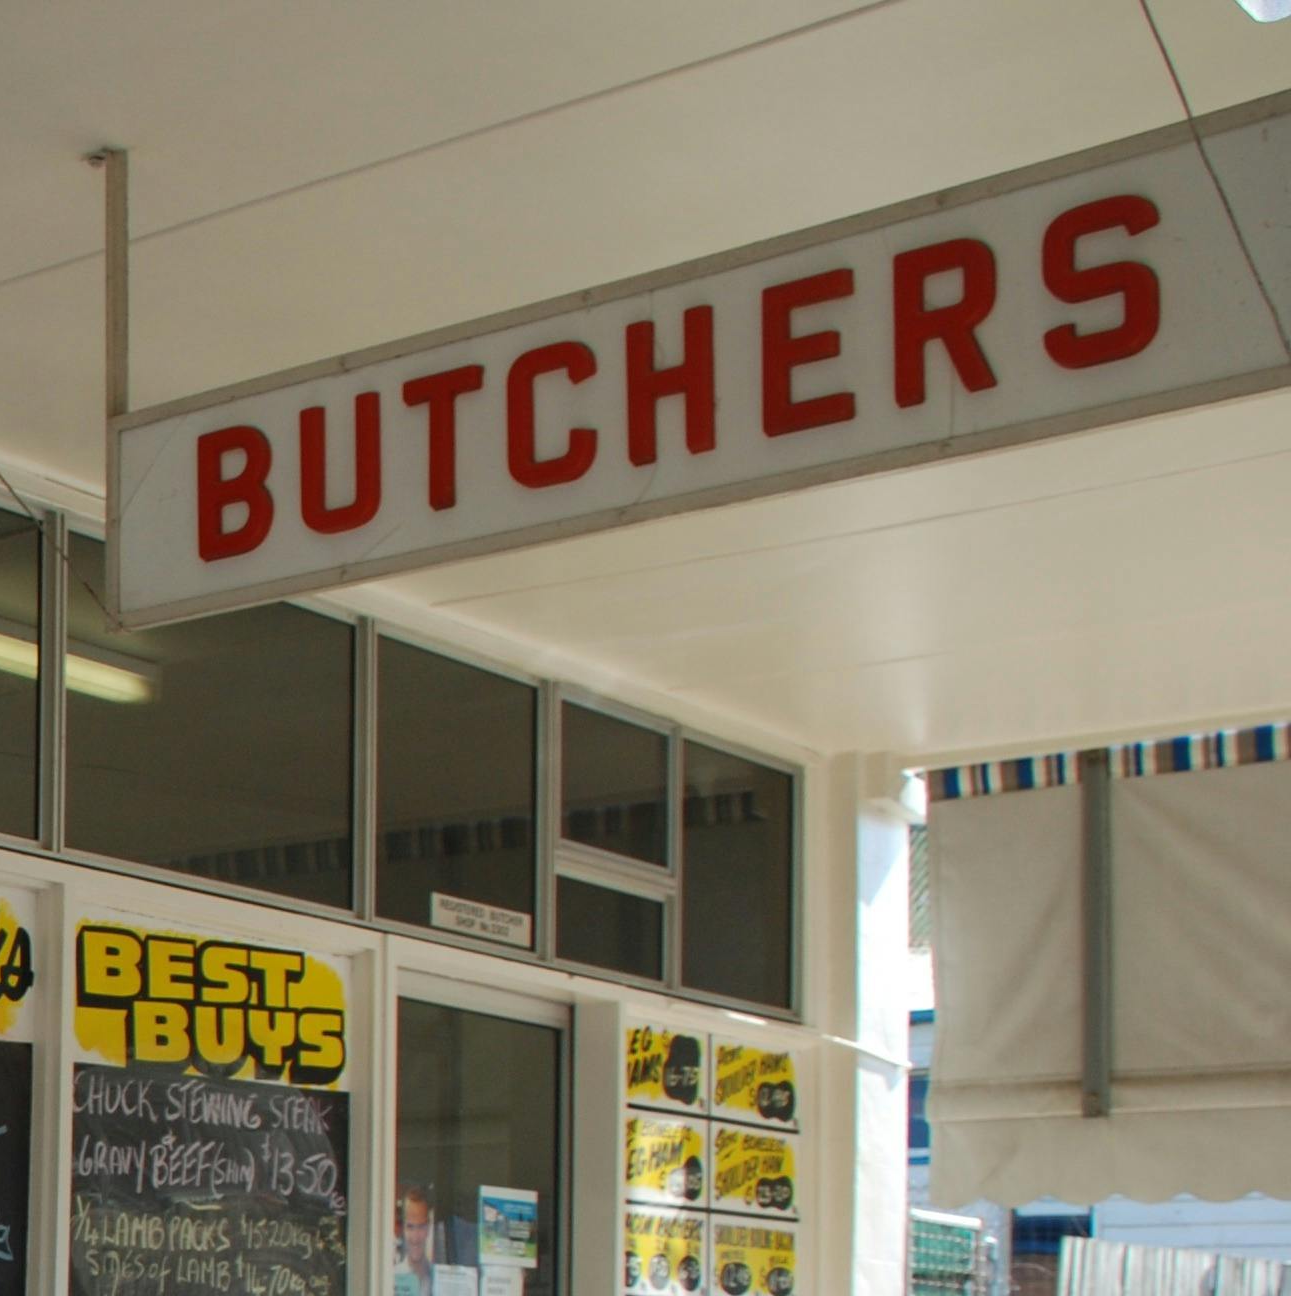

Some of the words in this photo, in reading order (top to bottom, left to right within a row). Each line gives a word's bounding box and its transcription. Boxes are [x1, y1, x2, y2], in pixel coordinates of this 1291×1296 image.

[196, 193, 1162, 564] BUTCHERS
[76, 925, 306, 1007] BEST
[127, 1000, 345, 1084] BUYS
[72, 1069, 157, 1123] CHUCK
[270, 1093, 333, 1133] STEAK
[102, 1211, 166, 1250] LAMB
[168, 1215, 231, 1252] PACKS
[176, 1255, 232, 1293] LAMB
